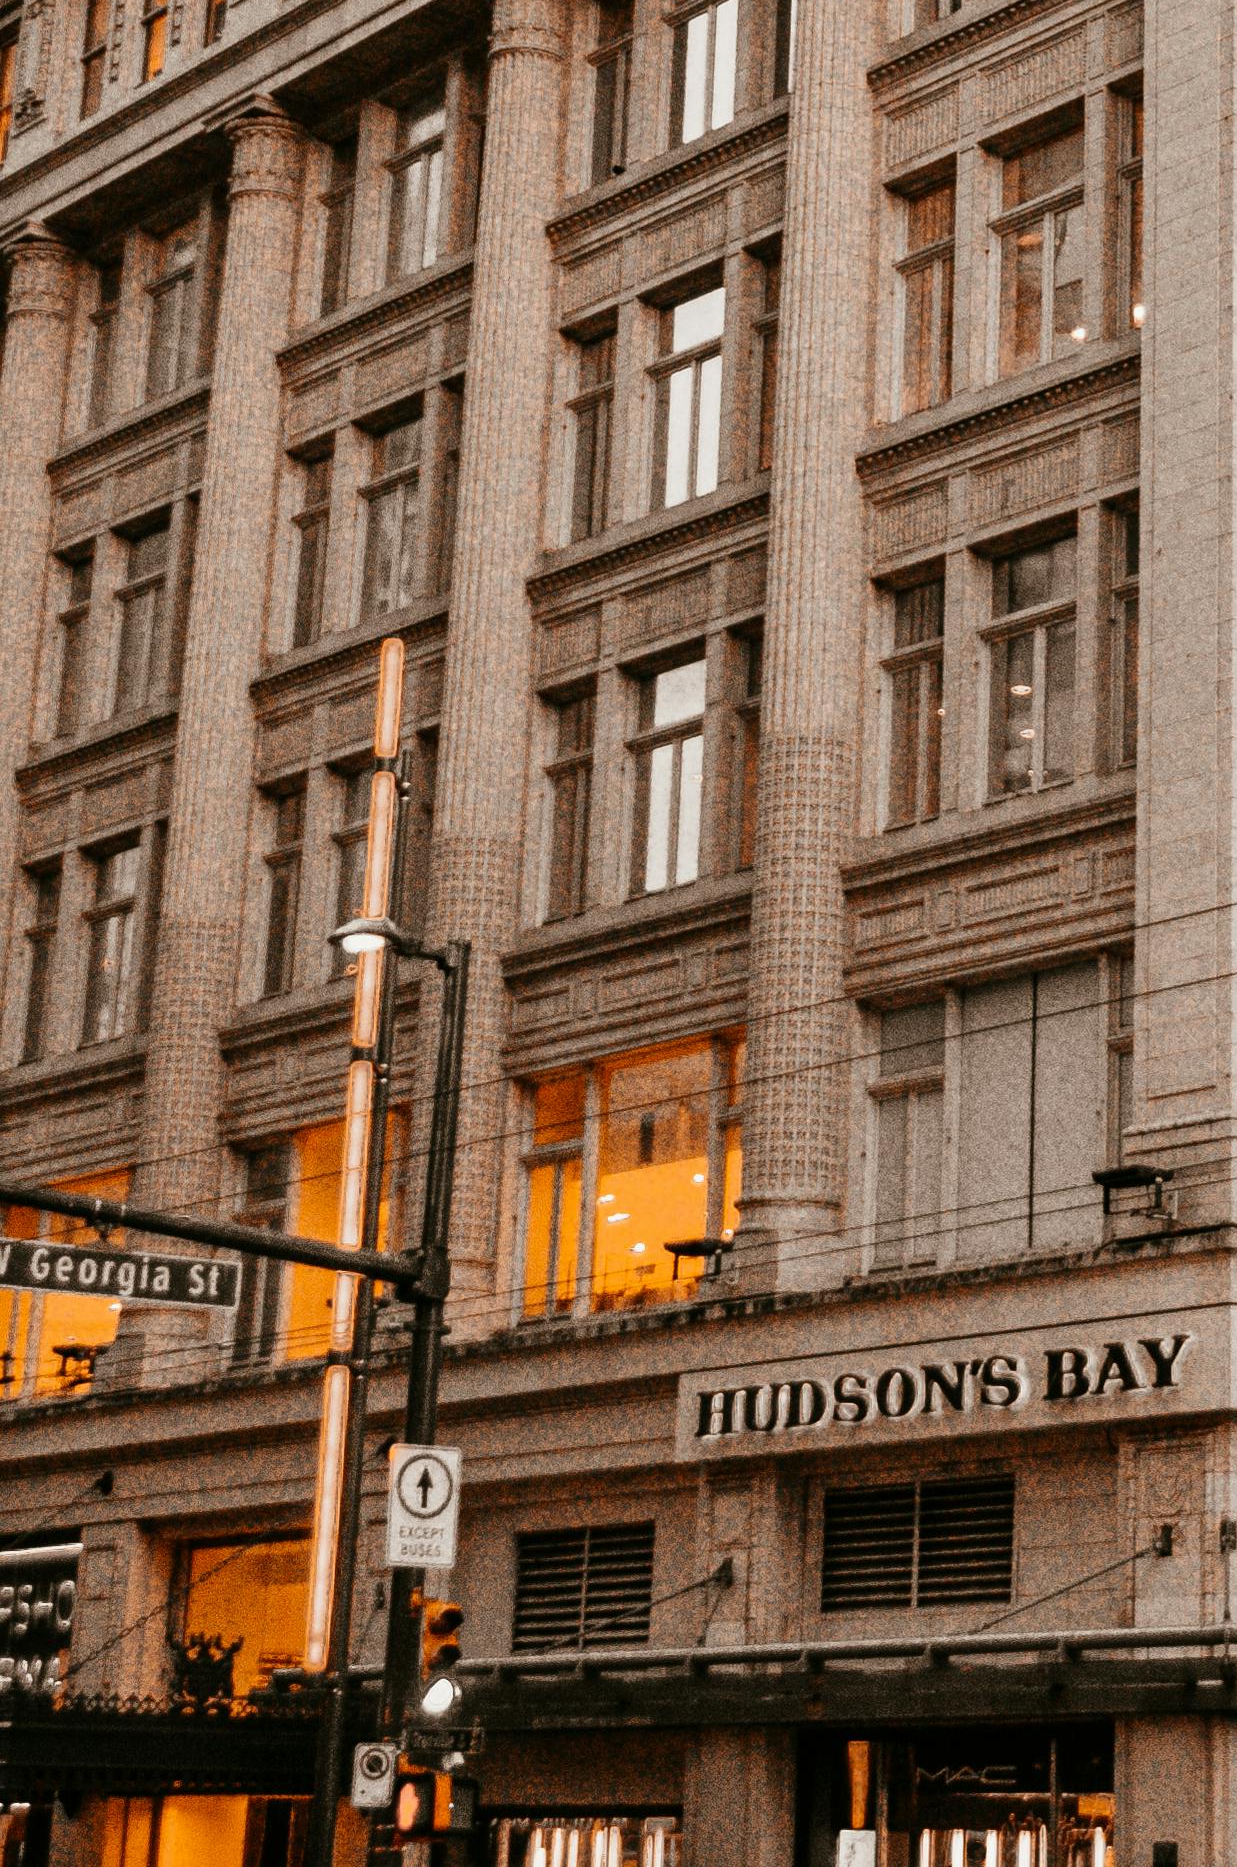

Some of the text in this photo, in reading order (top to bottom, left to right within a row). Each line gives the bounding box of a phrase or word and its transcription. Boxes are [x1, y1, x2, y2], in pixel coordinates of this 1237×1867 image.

[30, 1248, 170, 1296] Georgia
[188, 1263, 221, 1297] St
[695, 1334, 1190, 1438] HUDSON'S BAY
[399, 1525, 445, 1540] EXCEPT
[401, 1543, 441, 1557] BUSES
